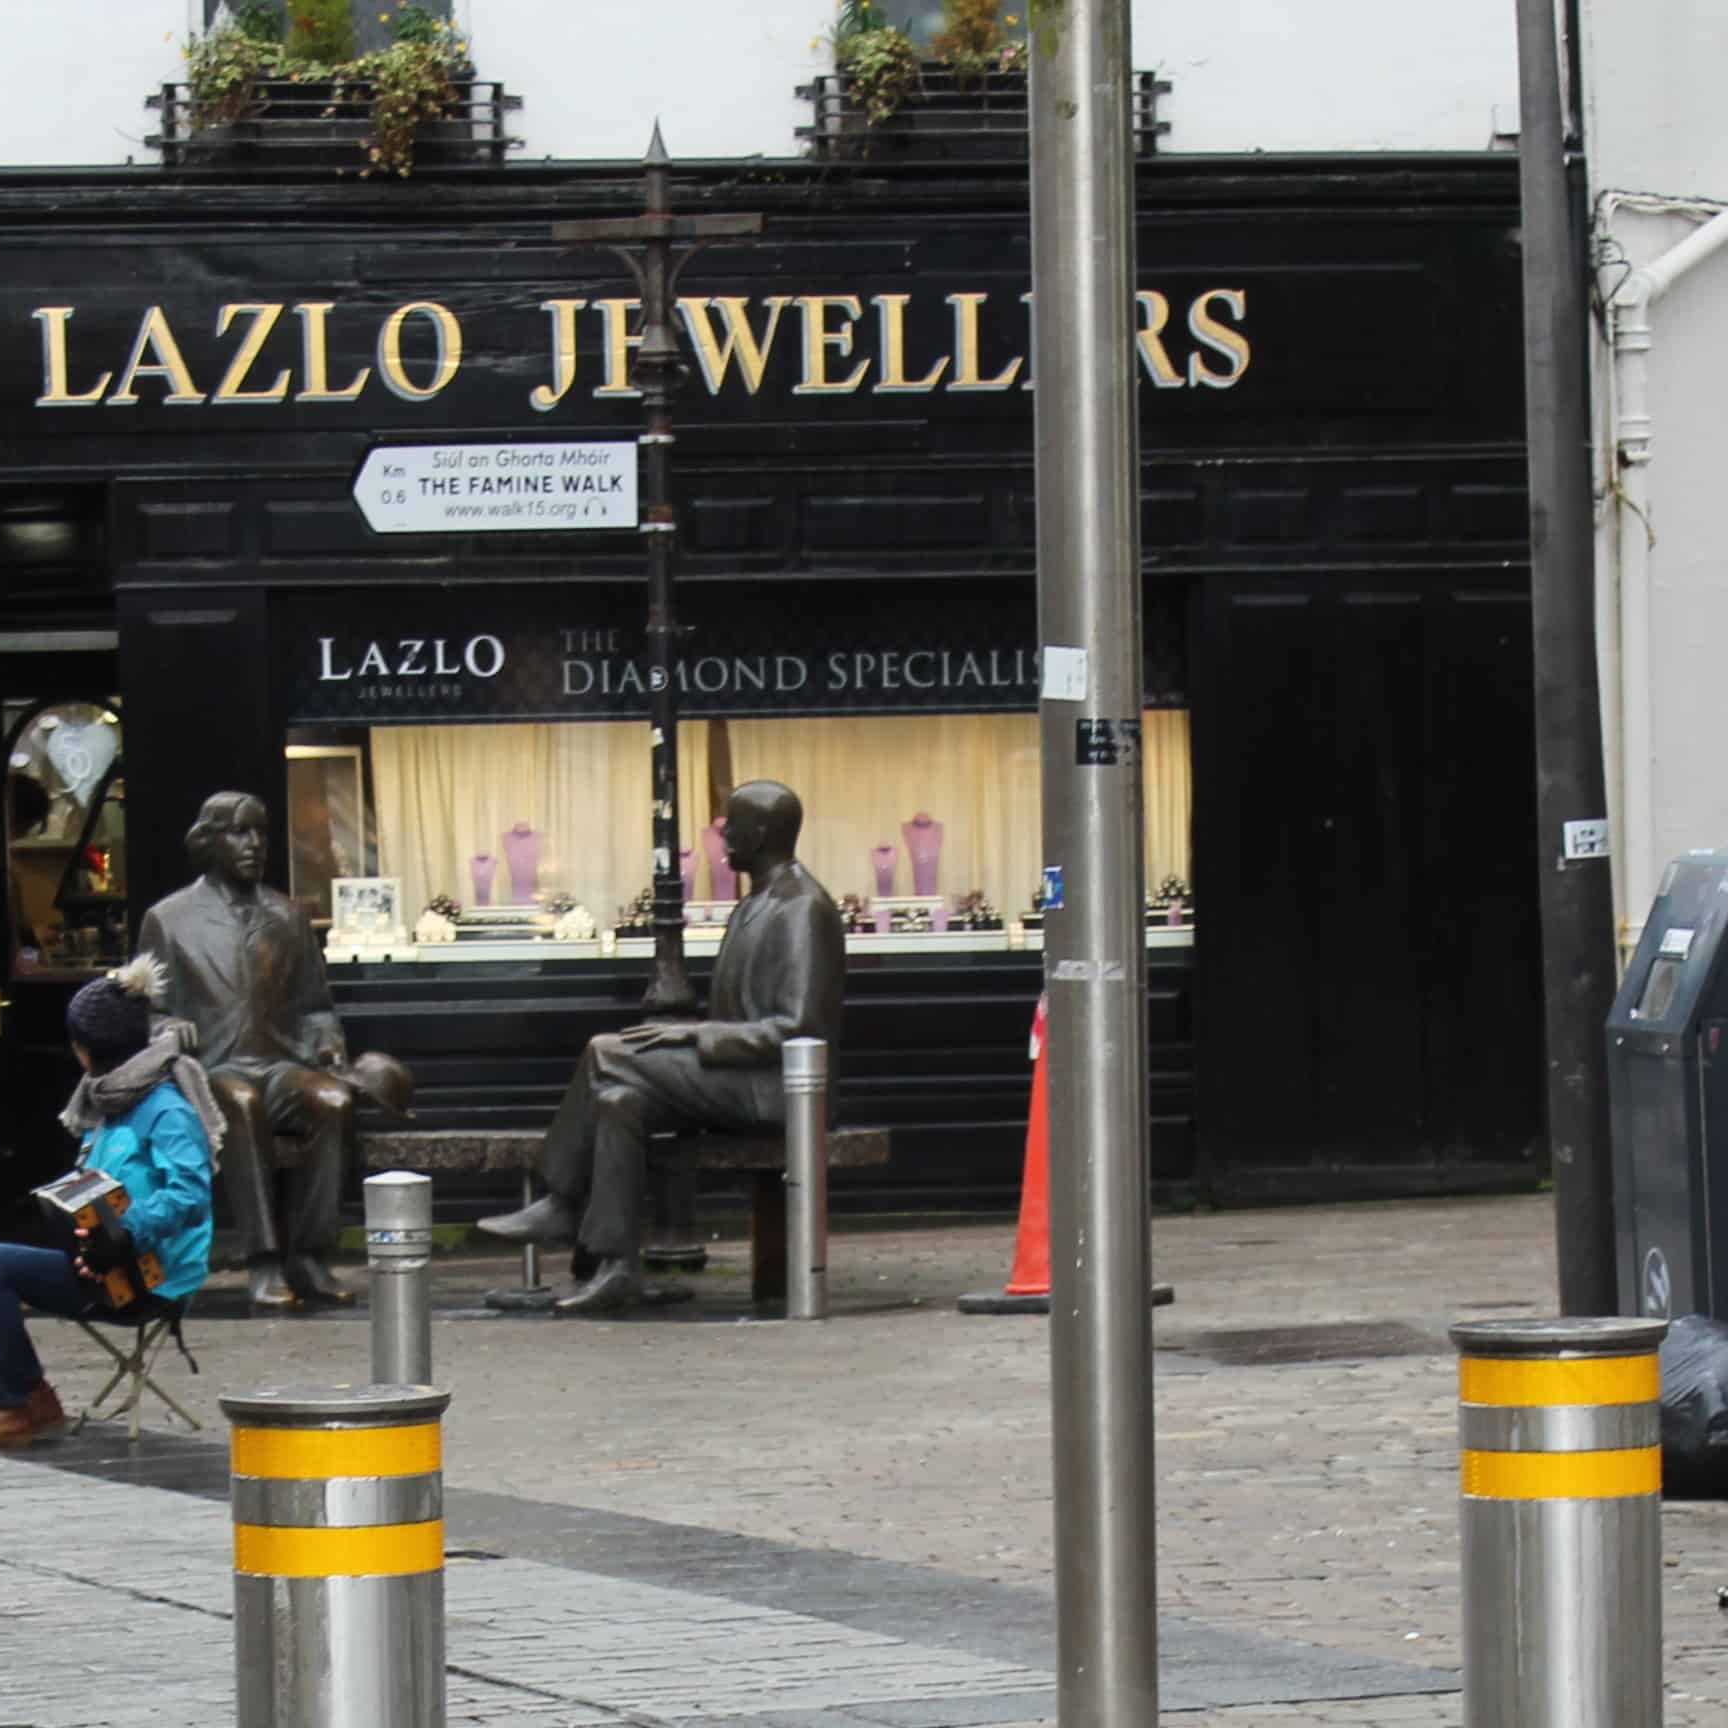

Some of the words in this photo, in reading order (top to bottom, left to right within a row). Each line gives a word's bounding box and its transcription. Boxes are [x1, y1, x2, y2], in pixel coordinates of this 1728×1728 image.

[31, 301, 463, 407] LAZLO
[529, 288, 1252, 412] JEWELLRS
[432, 449, 464, 470] Siúl
[468, 453, 490, 467] an
[495, 450, 555, 468] Ghorta
[559, 448, 612, 466] Mhóir
[382, 465, 406, 479] Km
[381, 489, 407, 505] 0.6
[418, 477, 461, 497] THE
[468, 475, 554, 495] FAMINE
[561, 474, 624, 494] WALK
[444, 500, 577, 520] www.walk15.org
[559, 628, 619, 654] THE
[318, 634, 505, 682] LAZLO
[827, 649, 1040, 691] SPECIALI
